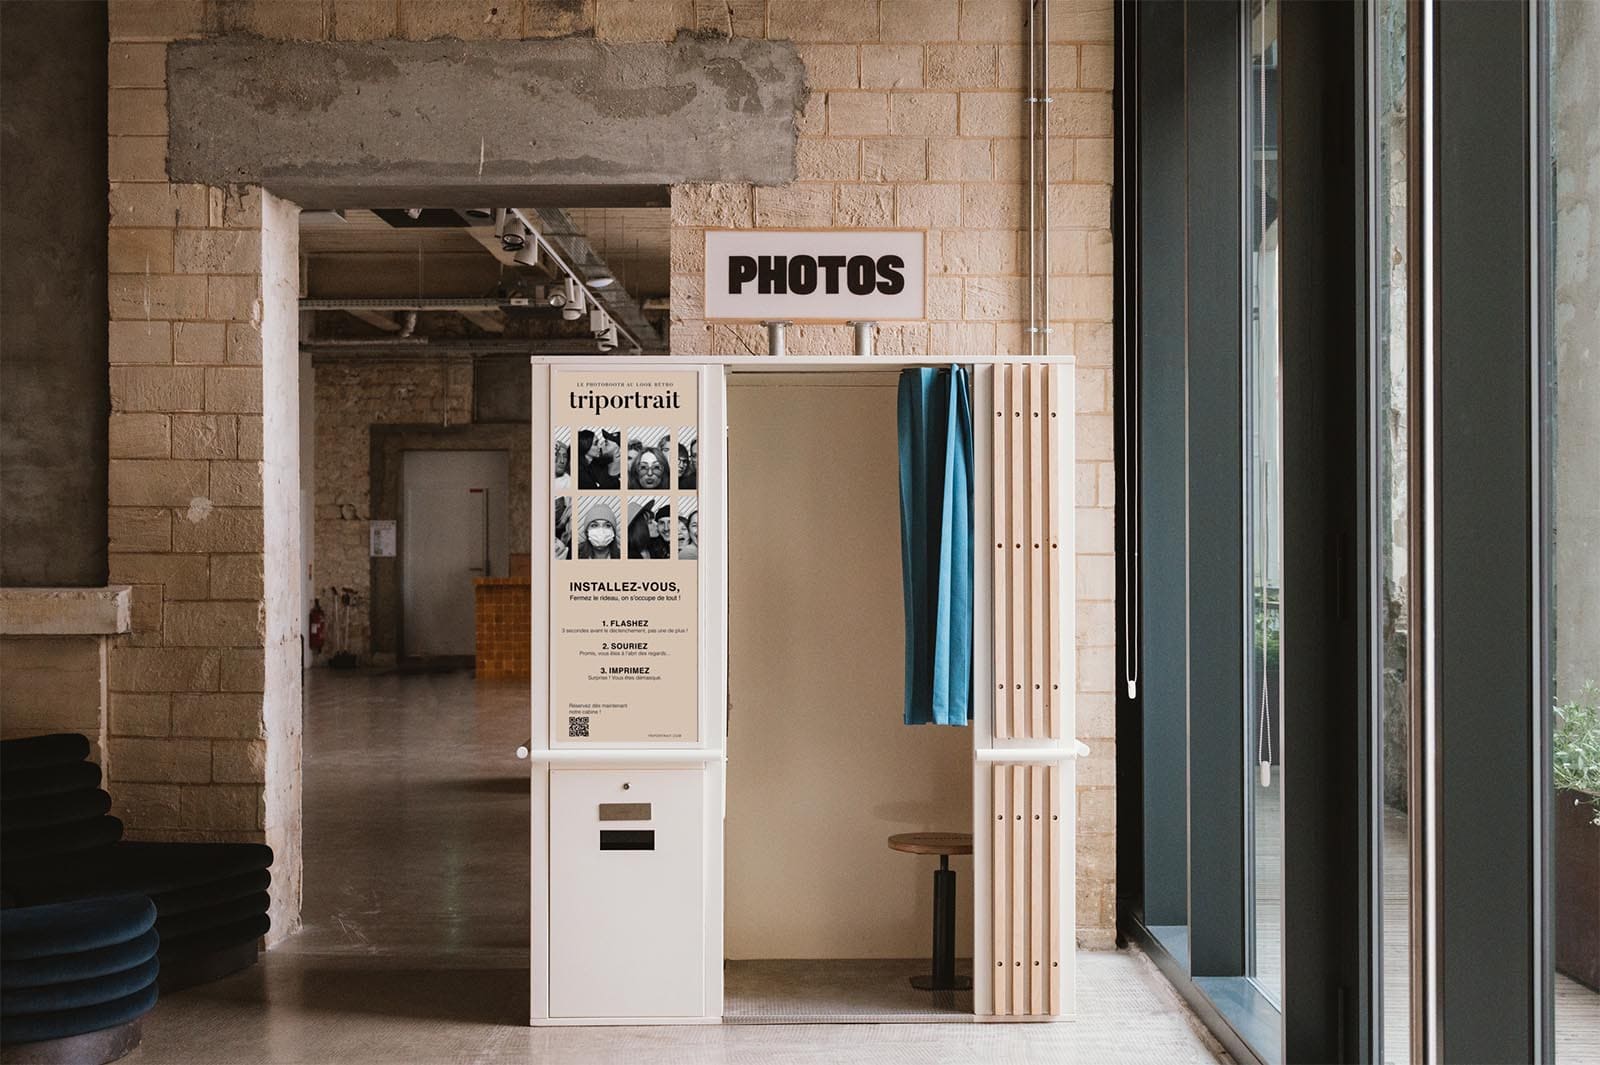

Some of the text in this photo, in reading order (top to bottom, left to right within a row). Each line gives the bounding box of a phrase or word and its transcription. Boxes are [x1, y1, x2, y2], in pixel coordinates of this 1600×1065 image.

[728, 255, 904, 295] PHOTOS
[570, 390, 680, 415] triportrait
[570, 582, 680, 592] INSTALLEZ-VOUS,
